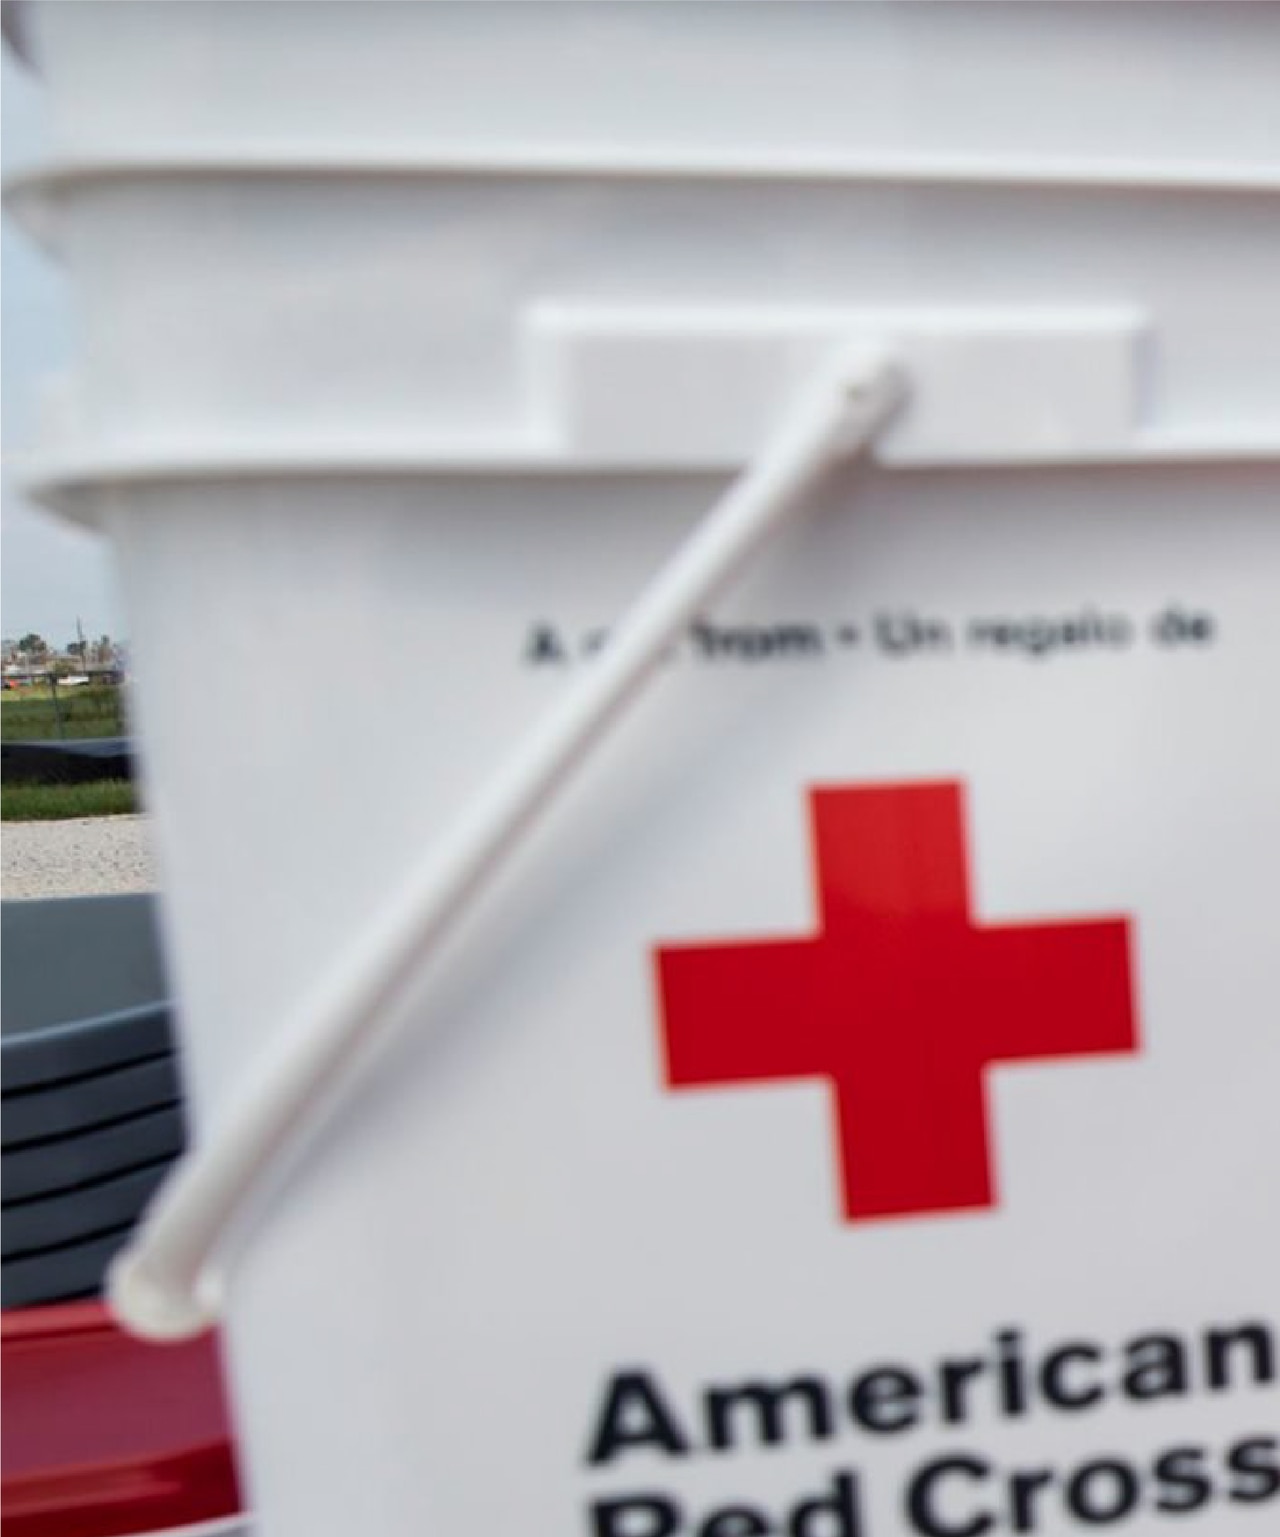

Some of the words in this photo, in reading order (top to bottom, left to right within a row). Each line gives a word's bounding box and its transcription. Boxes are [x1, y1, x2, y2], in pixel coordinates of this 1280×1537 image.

[870, 610, 951, 657] Un
[966, 613, 1130, 659] regalo
[1151, 608, 1214, 646] de
[586, 1320, 1277, 1468] American
